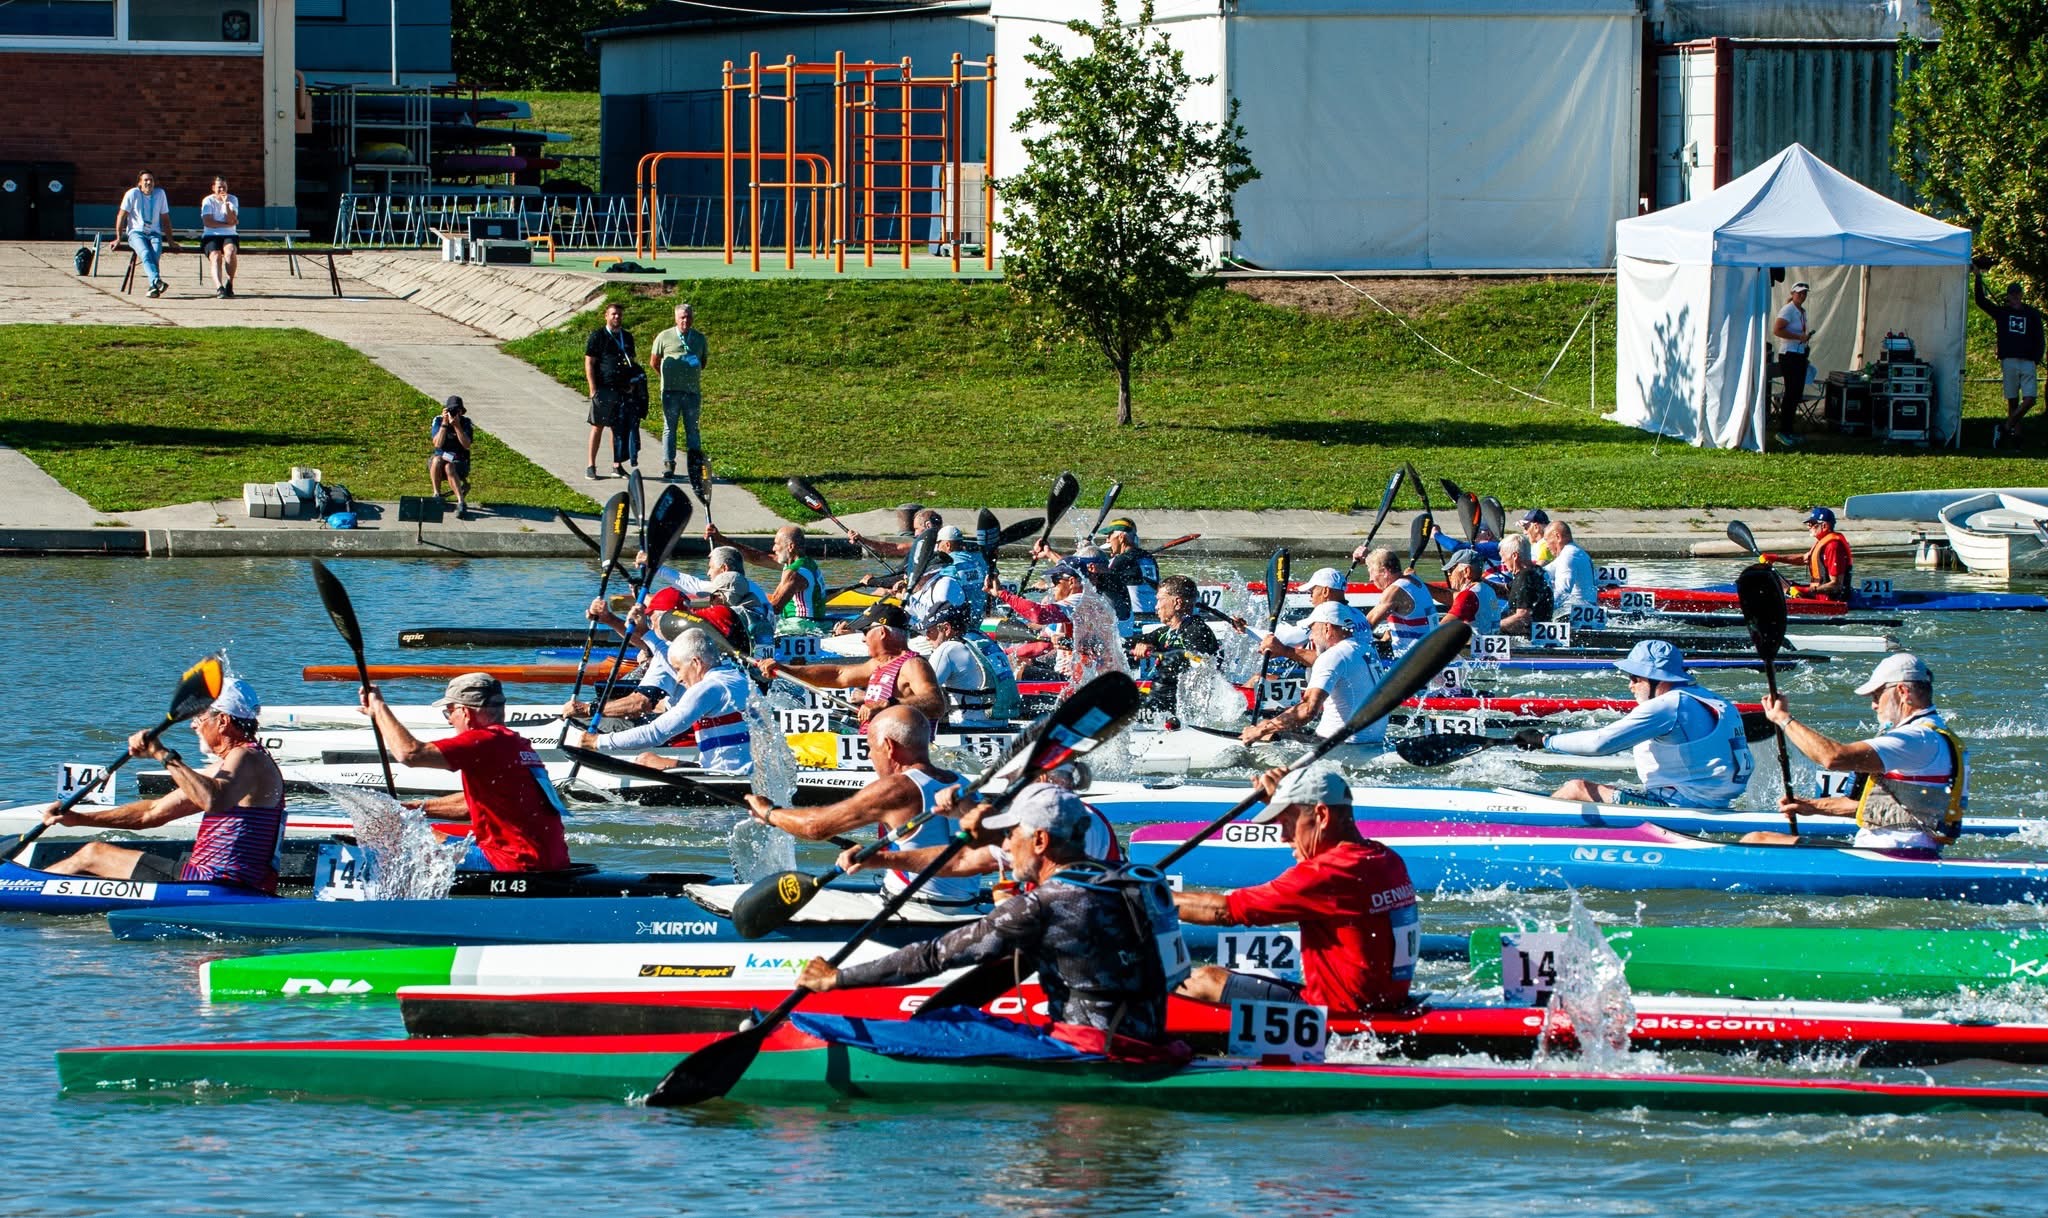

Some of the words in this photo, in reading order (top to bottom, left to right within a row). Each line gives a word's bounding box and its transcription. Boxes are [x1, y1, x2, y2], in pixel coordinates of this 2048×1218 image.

[1599, 567, 1627, 580] 210
[1863, 580, 1890, 592] 211
[1197, 590, 1221, 606] 07
[1623, 593, 1653, 607] 205
[1573, 607, 1605, 622] 204
[402, 633, 425, 642] epic
[1535, 624, 1567, 640] 201
[783, 639, 816, 655] 161
[1474, 637, 1507, 653] 162
[784, 712, 825, 733] 152
[842, 737, 870, 761] 15
[797, 777, 824, 785] AYAK
[827, 778, 865, 787] CENTRE
[1225, 825, 1278, 842] GBR
[1573, 847, 1663, 864] NELO
[56, 881, 73, 894] S.
[80, 881, 144, 898] LIGON
[490, 879, 506, 892] K1
[510, 879, 527, 892] 43
[653, 920, 717, 936] KIRTON
[1225, 935, 1294, 969] 142
[1519, 951, 1557, 987] 14
[1238, 1004, 1319, 1048] 156
